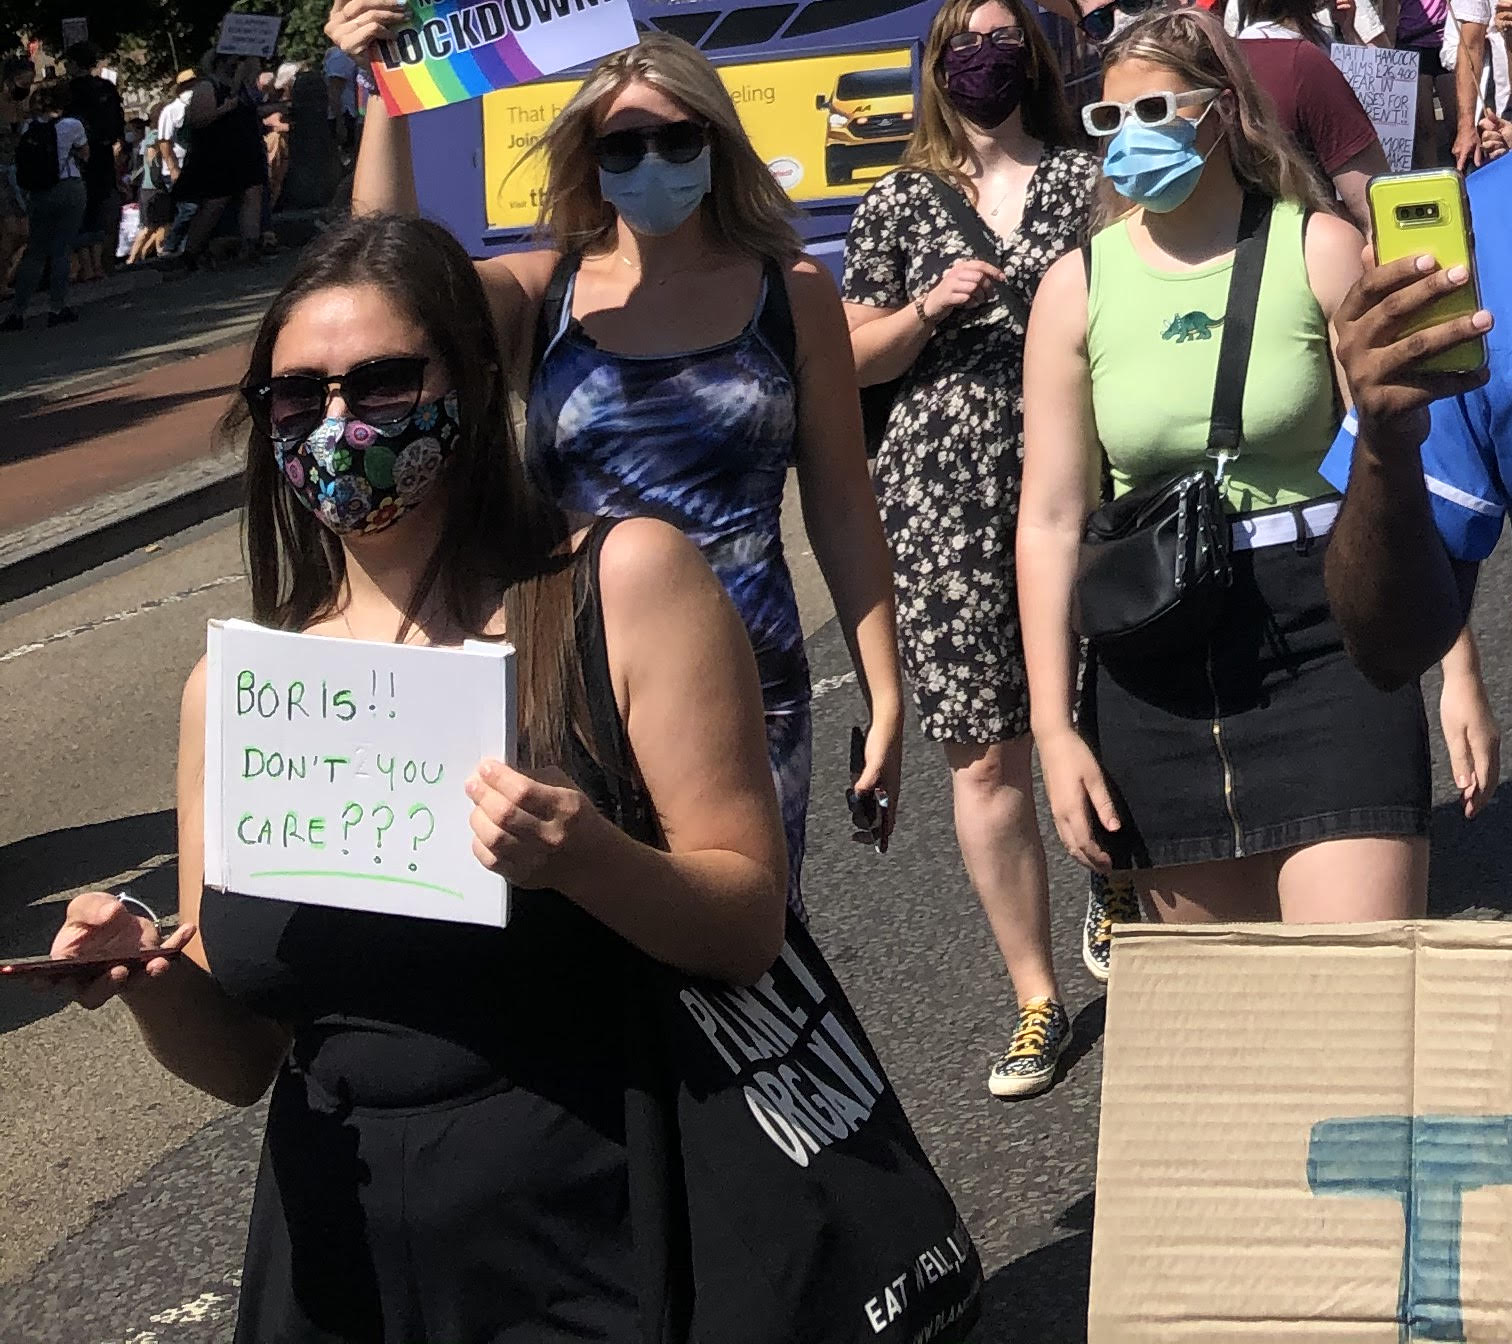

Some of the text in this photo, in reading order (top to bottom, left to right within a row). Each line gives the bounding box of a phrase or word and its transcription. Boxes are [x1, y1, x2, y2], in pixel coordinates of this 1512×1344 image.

[1334, 45, 1418, 66] MATT HANCOCK
[733, 85, 775, 105] eling
[1380, 78, 1394, 92] IN
[1388, 95, 1408, 109] FOR
[507, 105, 545, 124] That
[241, 747, 350, 783] DON'T
[864, 1272, 907, 1334] EAT
